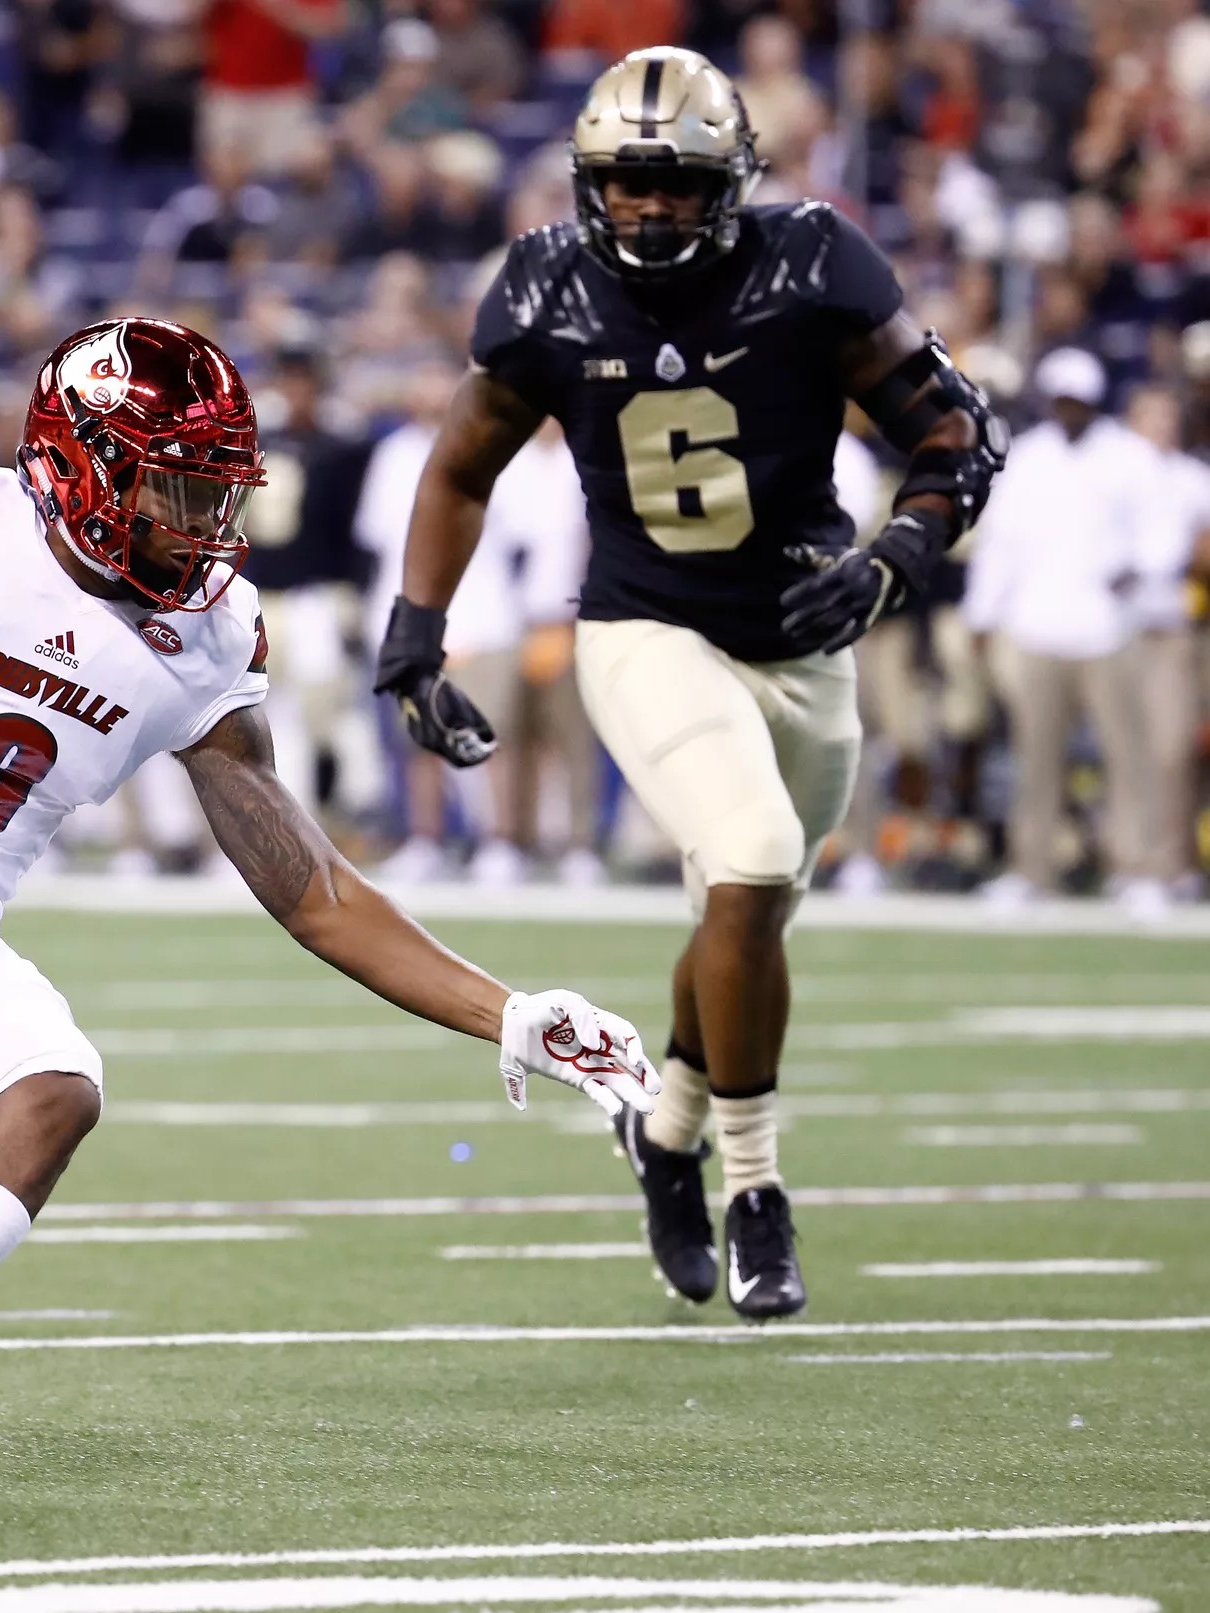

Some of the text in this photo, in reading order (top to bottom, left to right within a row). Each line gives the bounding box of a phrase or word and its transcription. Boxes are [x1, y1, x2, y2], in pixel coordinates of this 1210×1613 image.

[617, 386, 755, 554] 6
[143, 626, 181, 648] ACC
[34, 644, 80, 670] adidas
